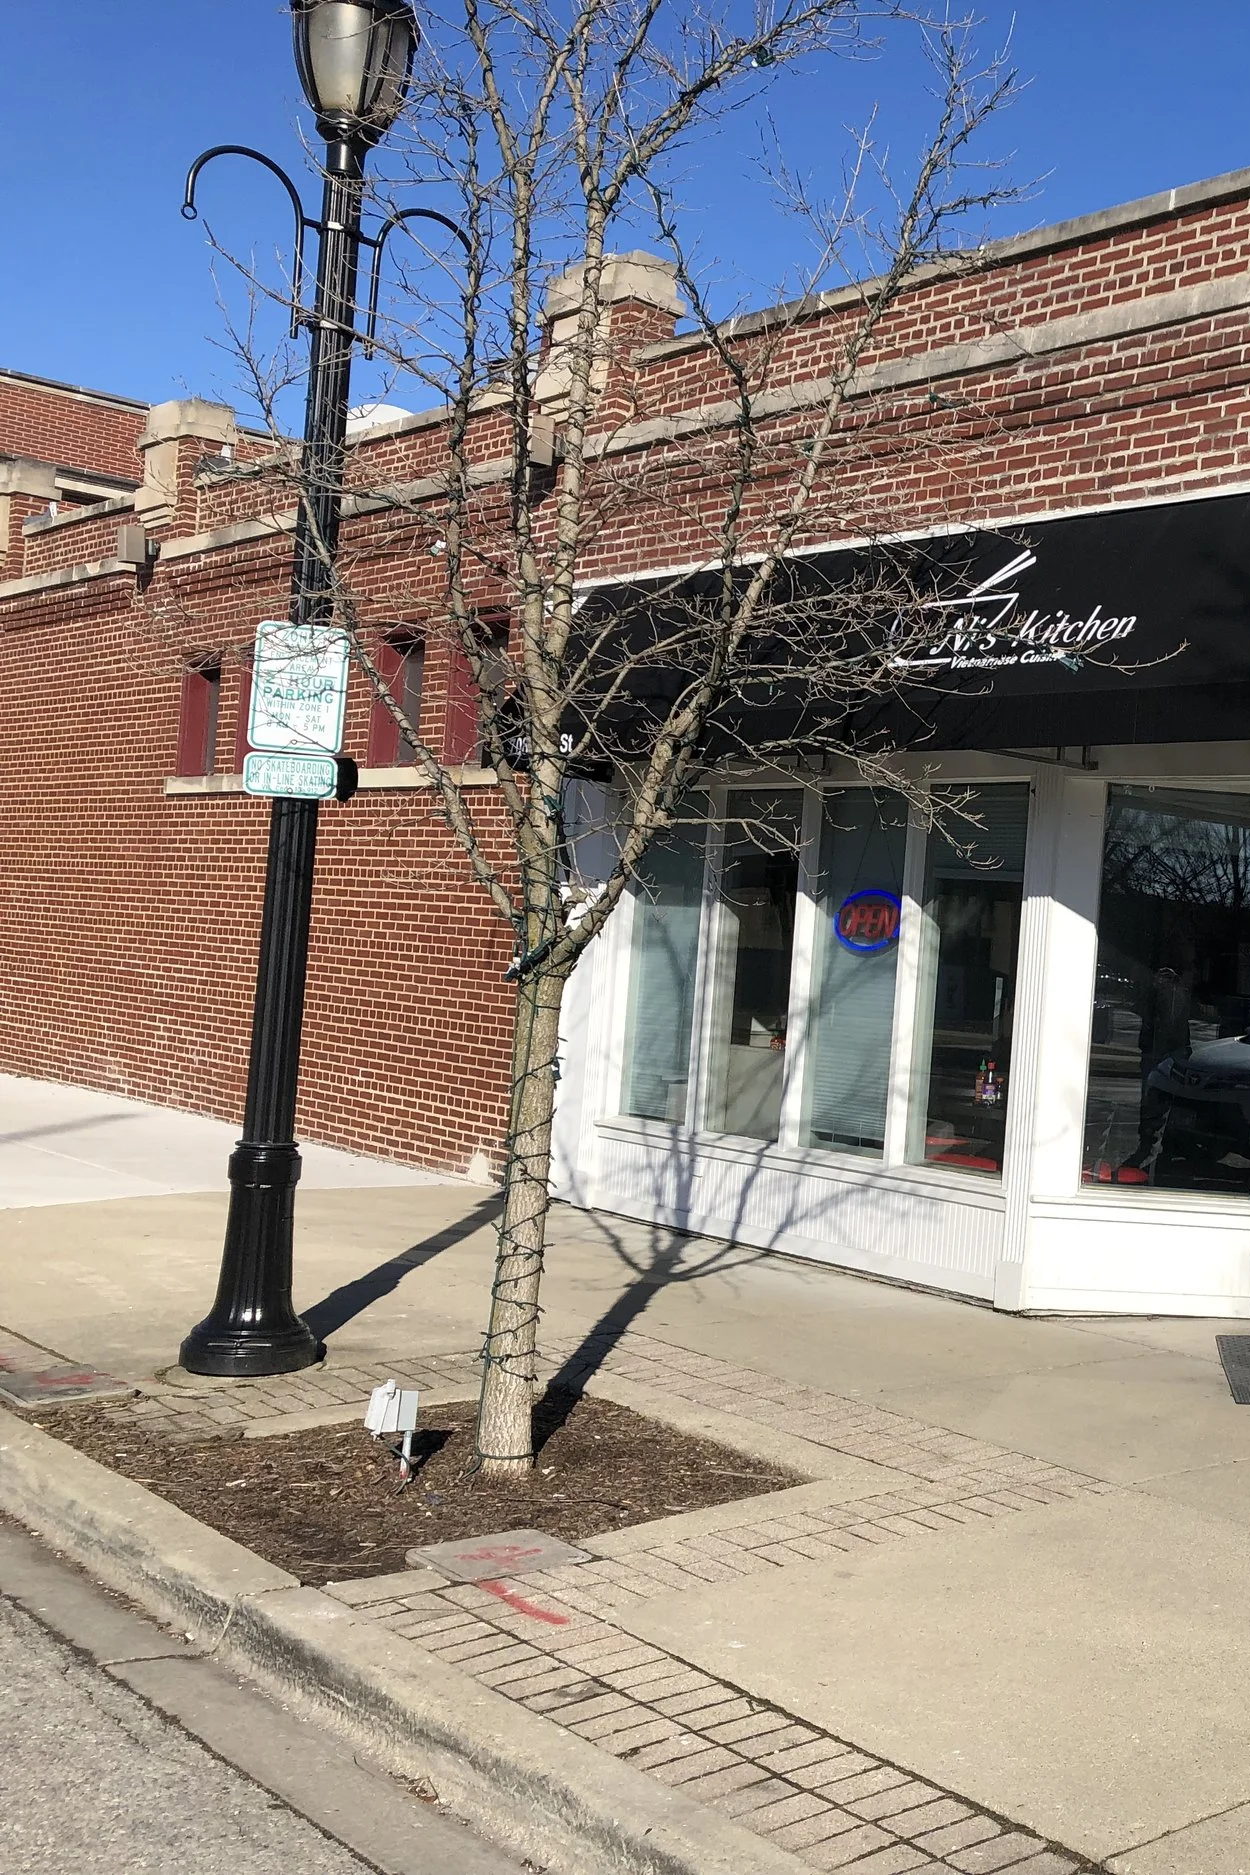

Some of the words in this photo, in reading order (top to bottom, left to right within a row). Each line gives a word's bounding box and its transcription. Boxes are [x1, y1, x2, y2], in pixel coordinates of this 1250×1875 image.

[1011, 604, 1137, 648] Kitchen
[289, 663, 314, 673] AREA
[950, 654, 1018, 670] Vietnamese
[1019, 649, 1064, 664] Cuisin
[289, 674, 334, 690] HOUR
[263, 686, 334, 704] PARKING
[266, 700, 295, 710] WITHIN
[299, 702, 322, 713] ZONE
[272, 711, 291, 721] MON
[305, 714, 321, 724] SAT
[303, 723, 309, 731] 5
[312, 724, 325, 733] PM
[559, 733, 573, 753] St
[252, 758, 262, 771] NO
[265, 759, 331, 776] SKATEBOARDING
[249, 771, 260, 783] OR
[263, 772, 295, 786] IN-LINE
[298, 775, 331, 788] SKATING
[839, 903, 899, 938] OPEN
